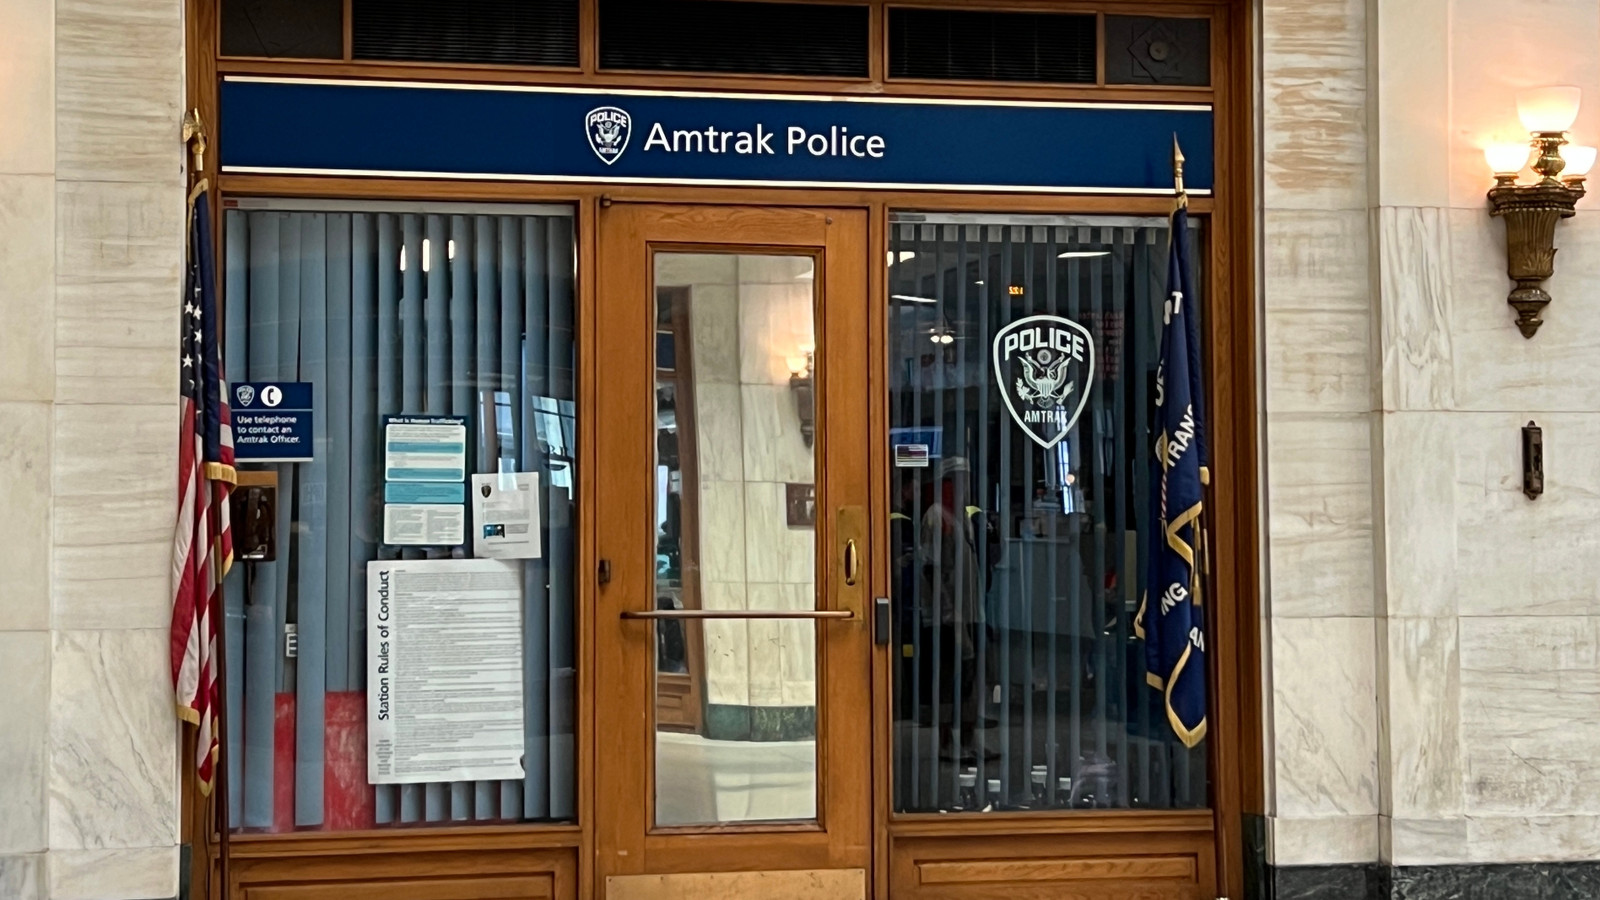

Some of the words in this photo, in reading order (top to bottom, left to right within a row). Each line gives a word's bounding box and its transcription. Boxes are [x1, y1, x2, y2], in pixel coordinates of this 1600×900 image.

[590, 111, 627, 127] POLICE
[643, 122, 775, 155] Amtrak
[787, 125, 886, 158] Police
[1004, 327, 1085, 362] POLICE
[236, 415, 253, 424] Use
[254, 415, 297, 425] telephone
[1024, 410, 1068, 423] AMTRAK
[236, 426, 247, 434] to
[248, 426, 279, 434] contact
[281, 426, 292, 434] an
[236, 435, 269, 444] Amtrak
[270, 435, 301, 444] Officer.
[378, 570, 390, 622] Conduct
[377, 625, 390, 638] of
[378, 641, 390, 673] Rules
[378, 678, 390, 720] Station
